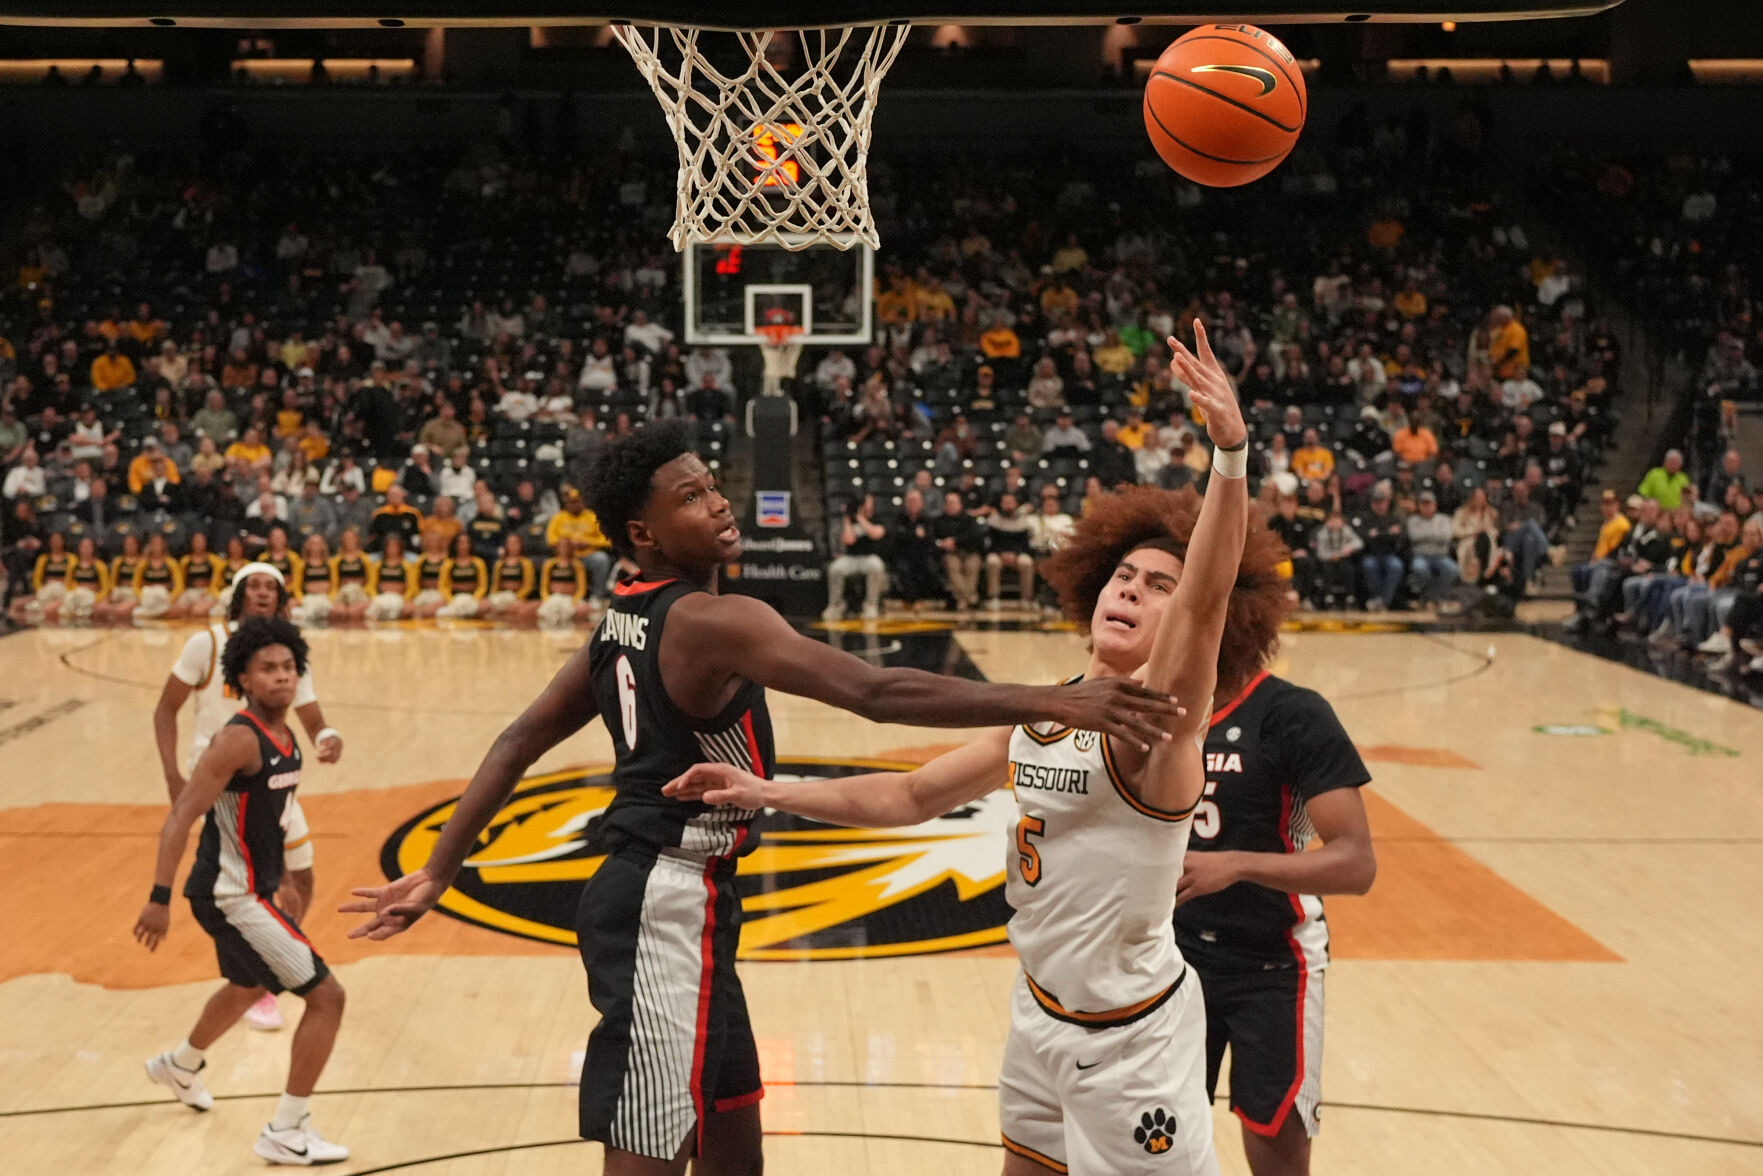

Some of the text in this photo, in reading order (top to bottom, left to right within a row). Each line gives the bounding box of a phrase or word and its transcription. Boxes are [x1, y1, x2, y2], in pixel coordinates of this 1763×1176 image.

[615, 654, 637, 751] 6
[1014, 761, 1090, 795] ISSOURI
[1016, 814, 1046, 888] 5
